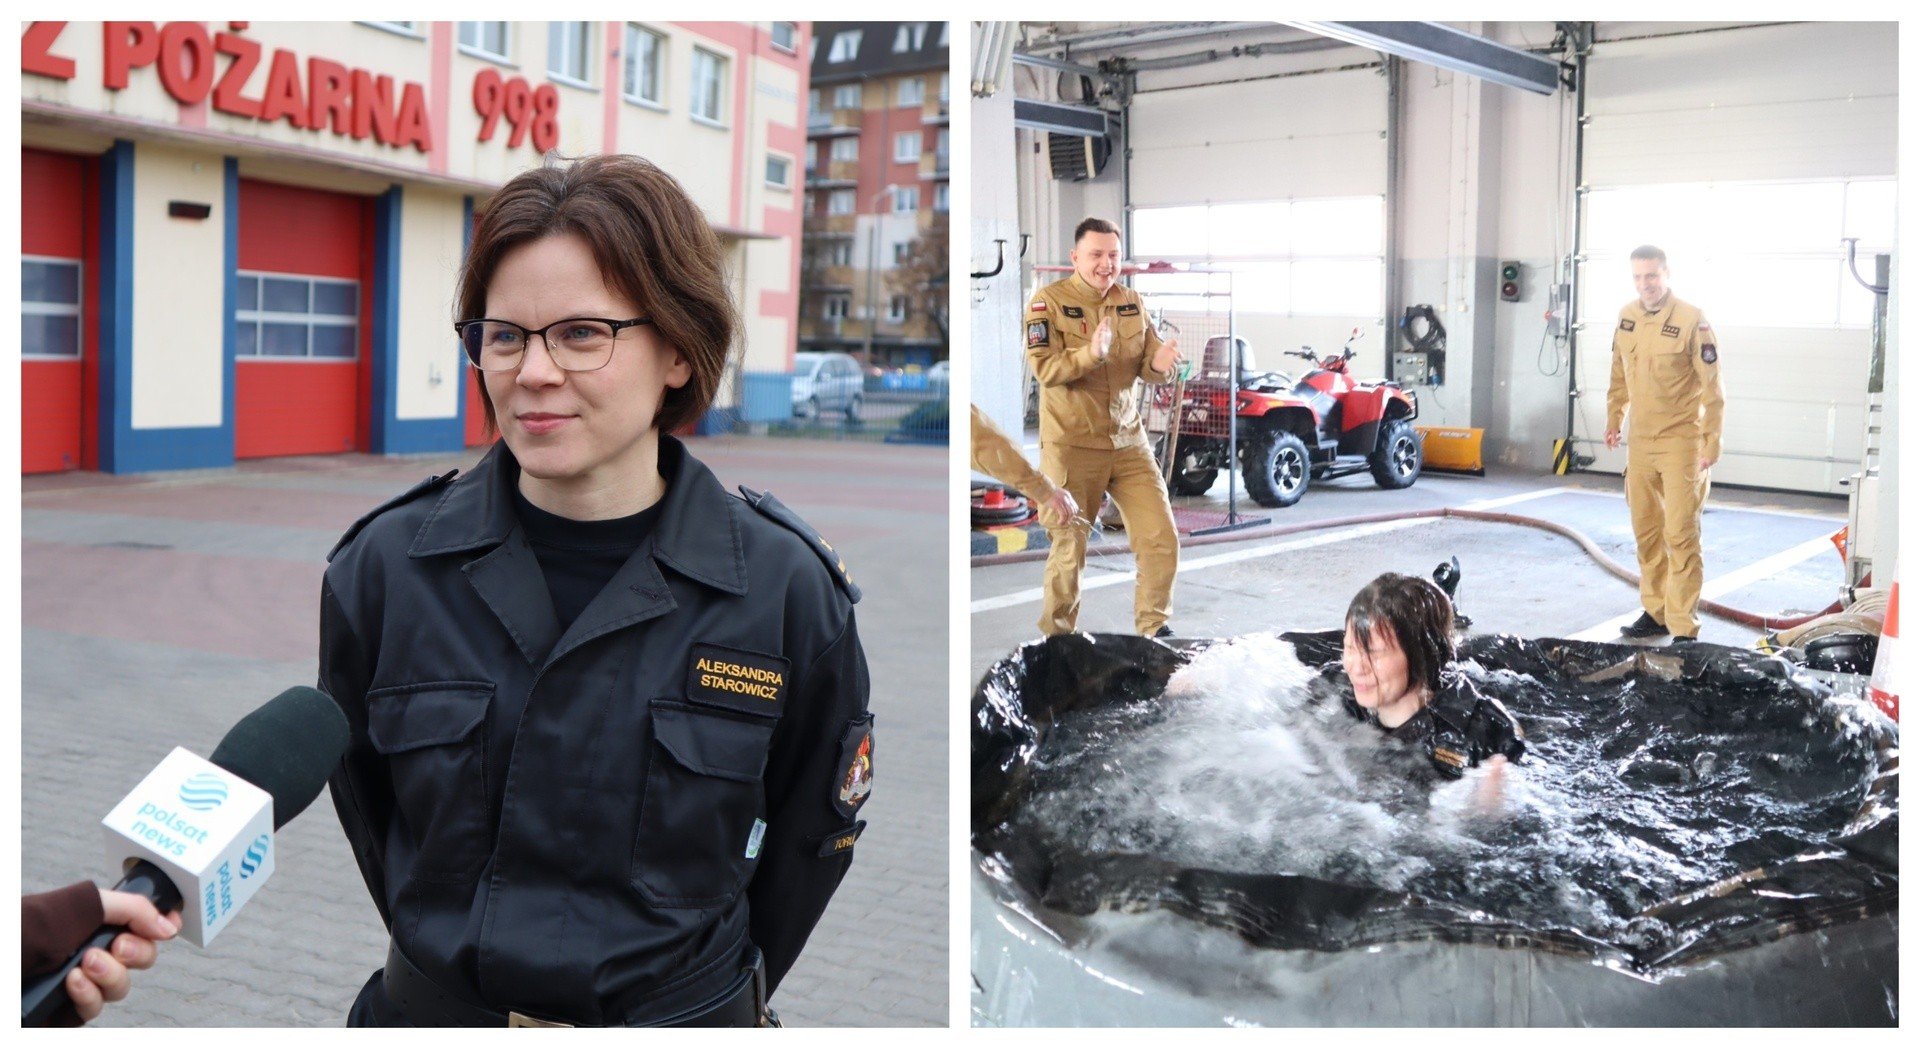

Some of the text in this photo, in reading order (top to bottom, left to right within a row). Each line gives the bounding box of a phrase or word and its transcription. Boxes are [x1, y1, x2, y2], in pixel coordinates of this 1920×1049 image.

[103, 21, 432, 152] POŻARNA
[472, 68, 560, 154] 998
[697, 658, 783, 685] ALEKSANDRA
[701, 675, 778, 699] STAROWICZ
[132, 821, 186, 855] news
[138, 802, 208, 843] polsat
[205, 882, 217, 925] news
[217, 861, 232, 915] polsat
